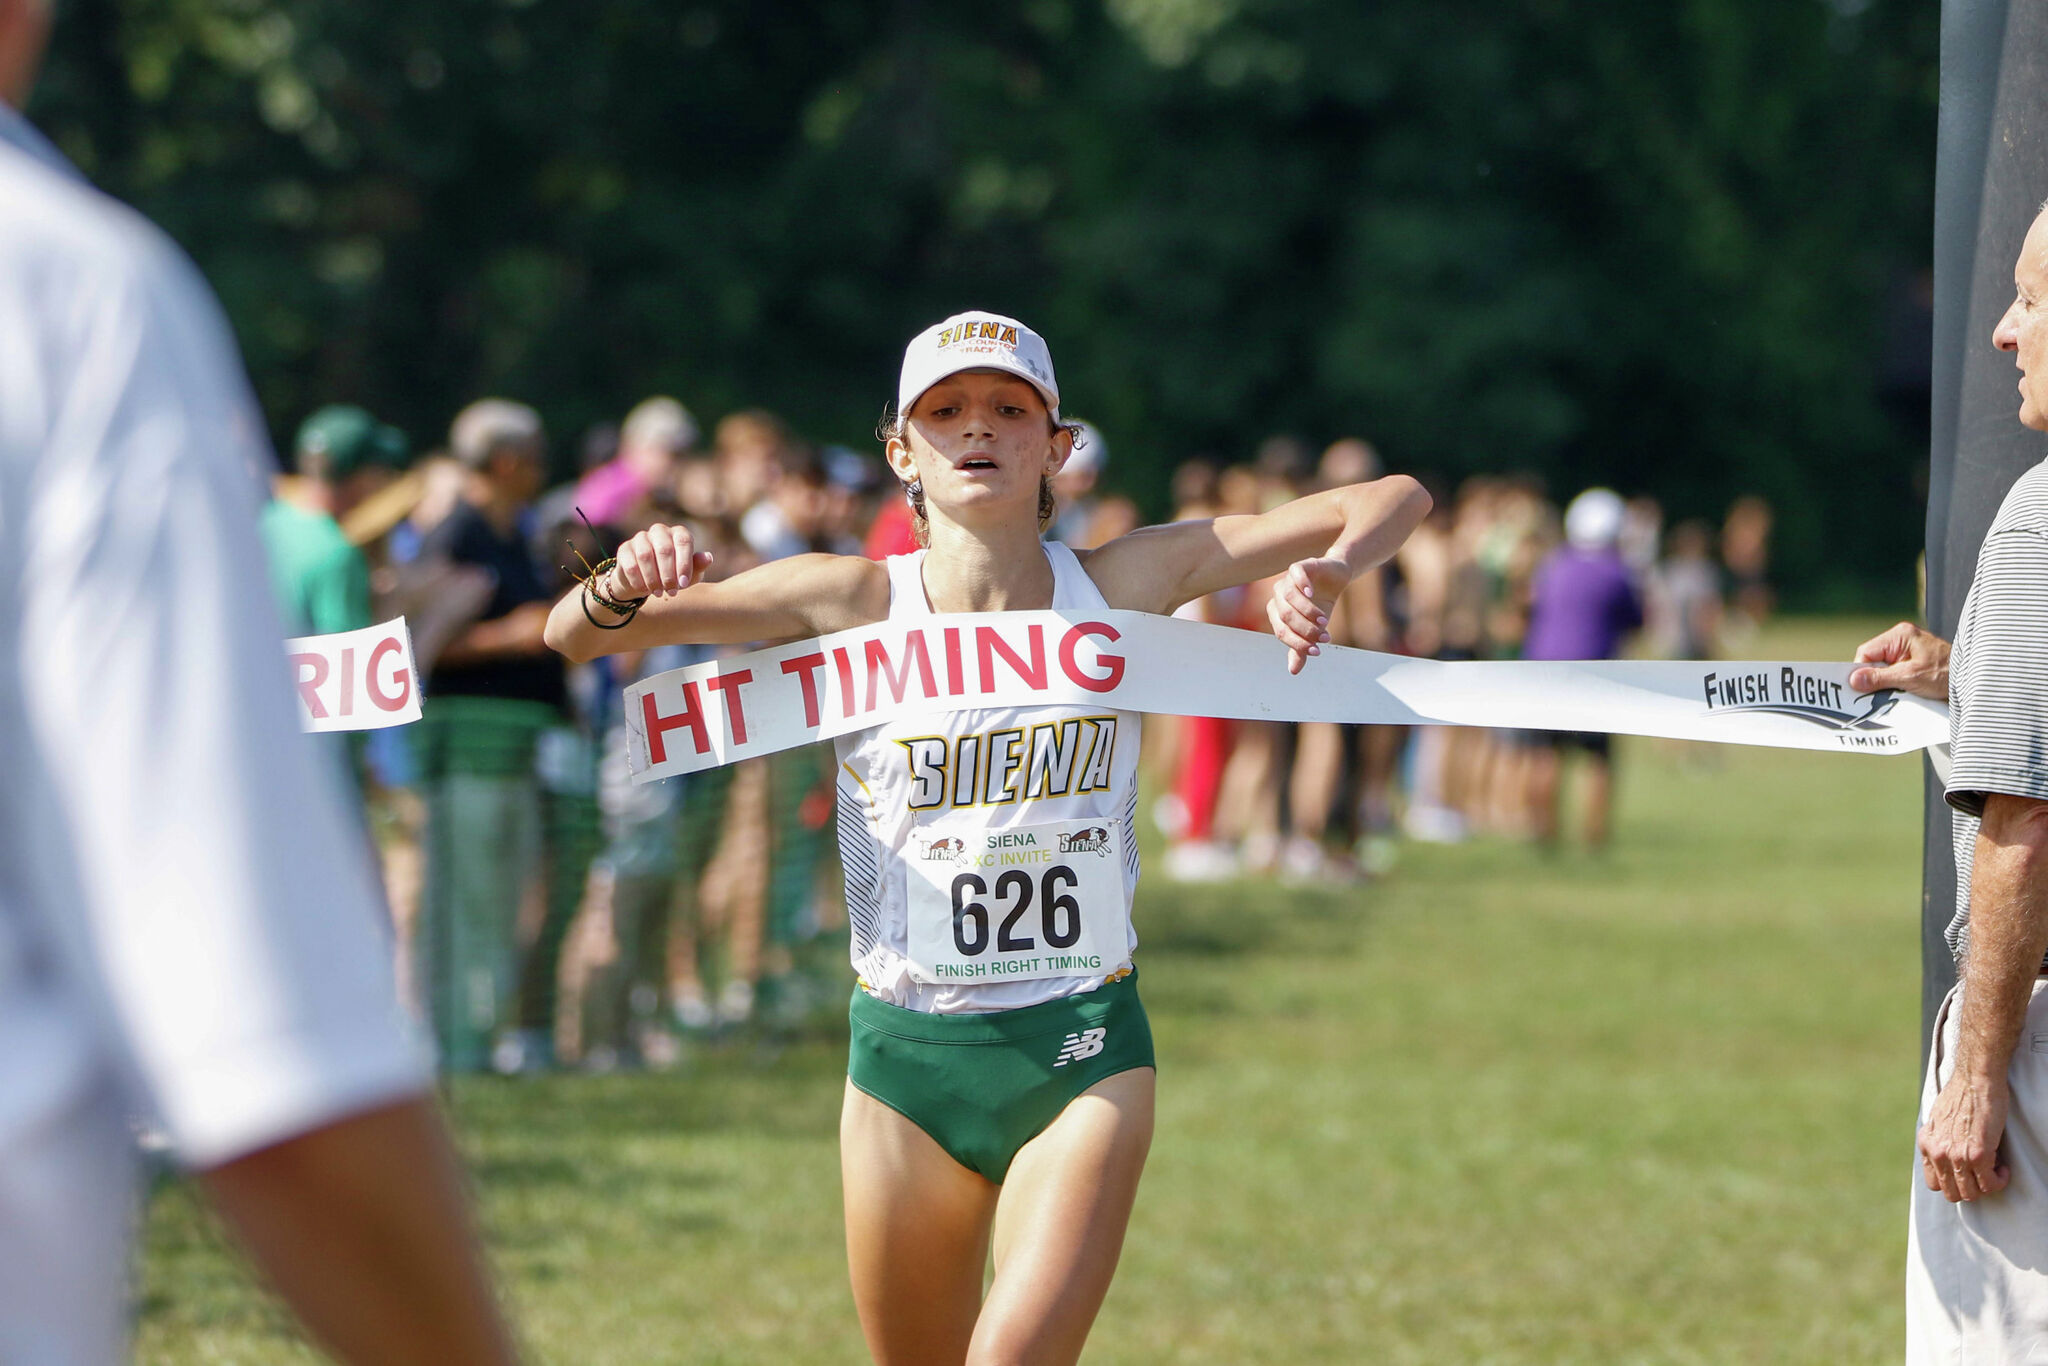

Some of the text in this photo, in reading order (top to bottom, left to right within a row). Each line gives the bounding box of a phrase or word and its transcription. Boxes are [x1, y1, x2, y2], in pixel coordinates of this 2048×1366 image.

[938, 321, 1017, 348] SIENA
[642, 621, 1125, 764] HT TIMING
[892, 714, 1117, 811] SIENA
[987, 833, 1036, 849] SIENA
[974, 850, 1052, 867] XC INVITE
[951, 865, 1081, 956] 626
[935, 955, 1101, 977] FINISH RIGHT TIMING
